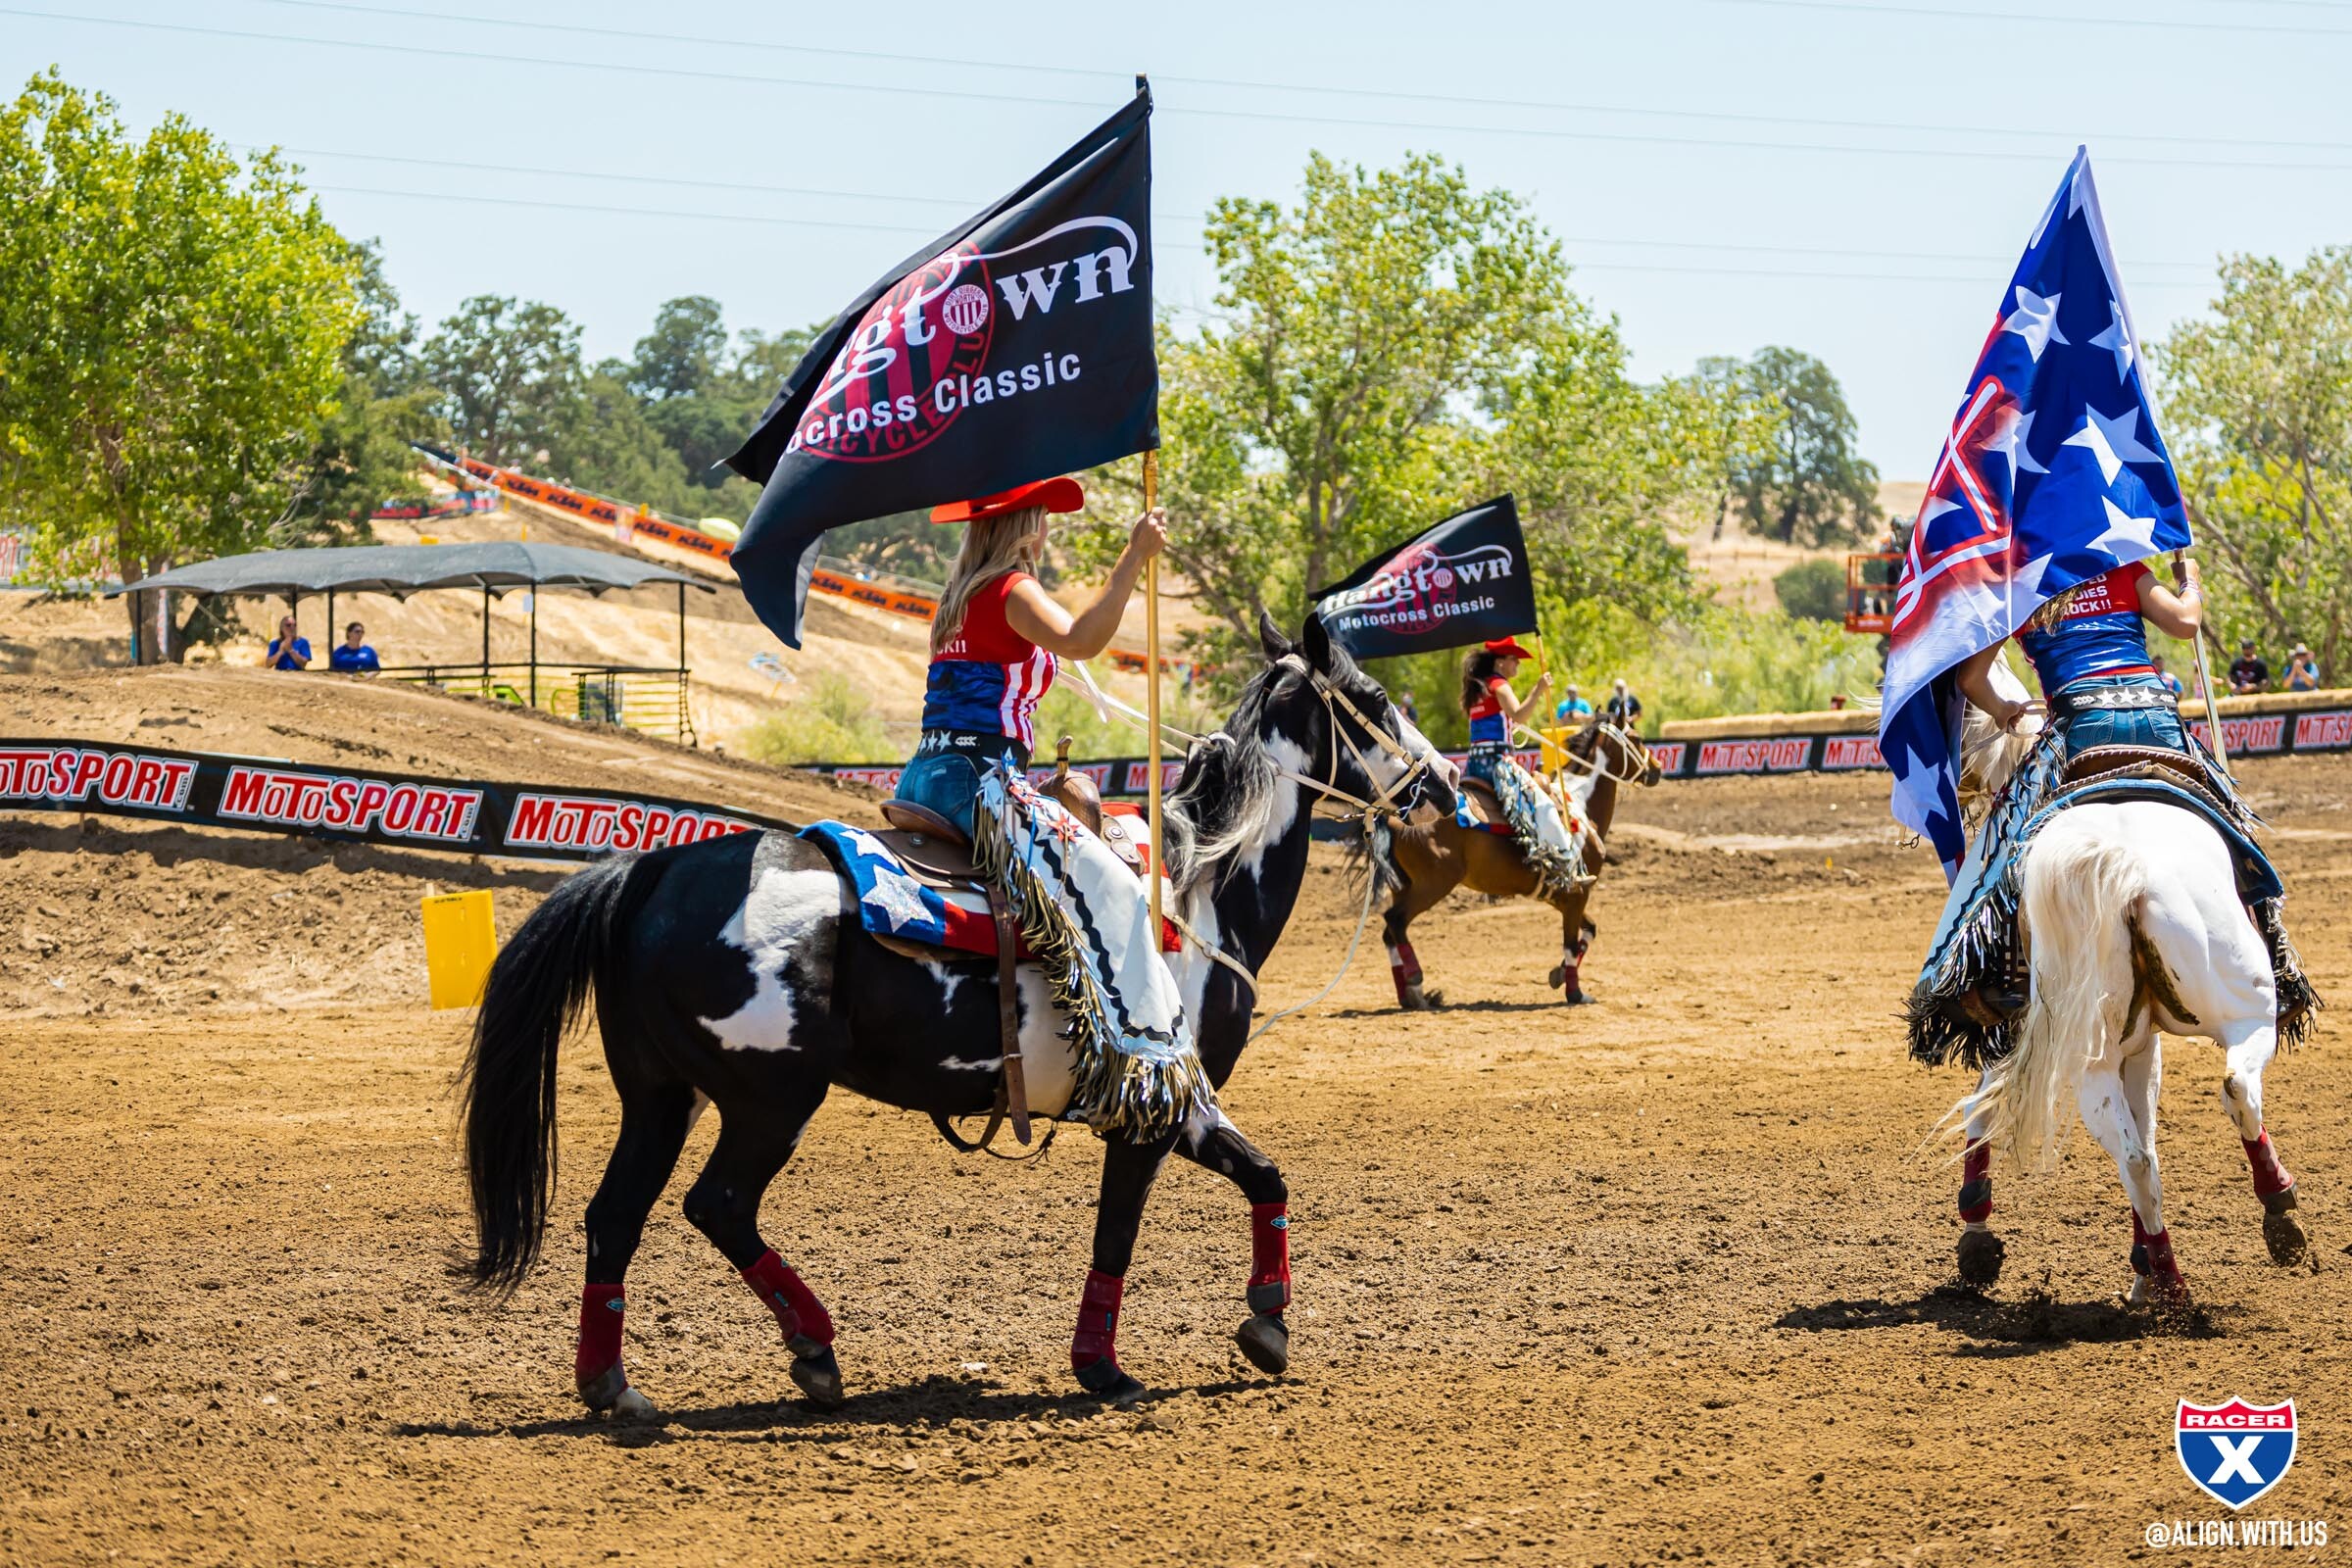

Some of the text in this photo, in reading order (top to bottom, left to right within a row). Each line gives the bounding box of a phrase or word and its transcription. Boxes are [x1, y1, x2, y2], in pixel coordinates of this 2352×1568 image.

[786, 352, 1082, 455] ocross Classic
[1339, 607, 1428, 632] Motocross
[1433, 595, 1495, 618] Classic
